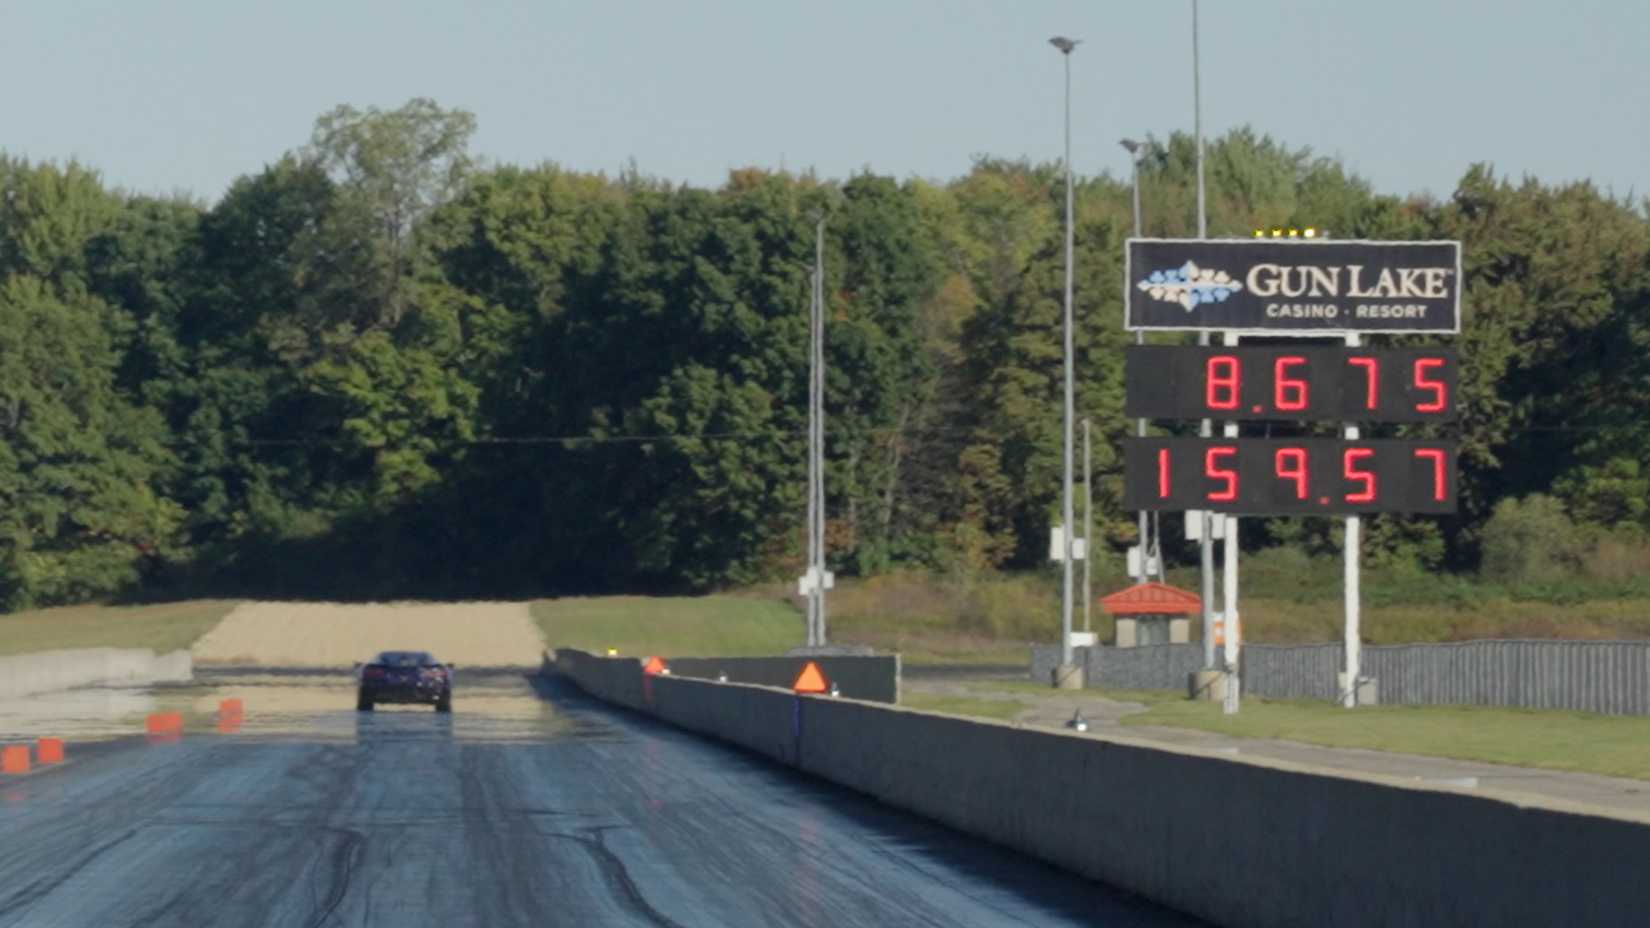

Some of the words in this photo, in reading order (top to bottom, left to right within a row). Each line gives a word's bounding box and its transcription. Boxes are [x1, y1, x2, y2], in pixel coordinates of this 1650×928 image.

[1246, 263, 1342, 298] GUN
[1346, 265, 1448, 299] LAKE
[1266, 303, 1338, 318] CASINO
[1356, 304, 1428, 318] RESORT
[1206, 356, 1447, 412] 8.675
[1157, 447, 1447, 505] 159.57
